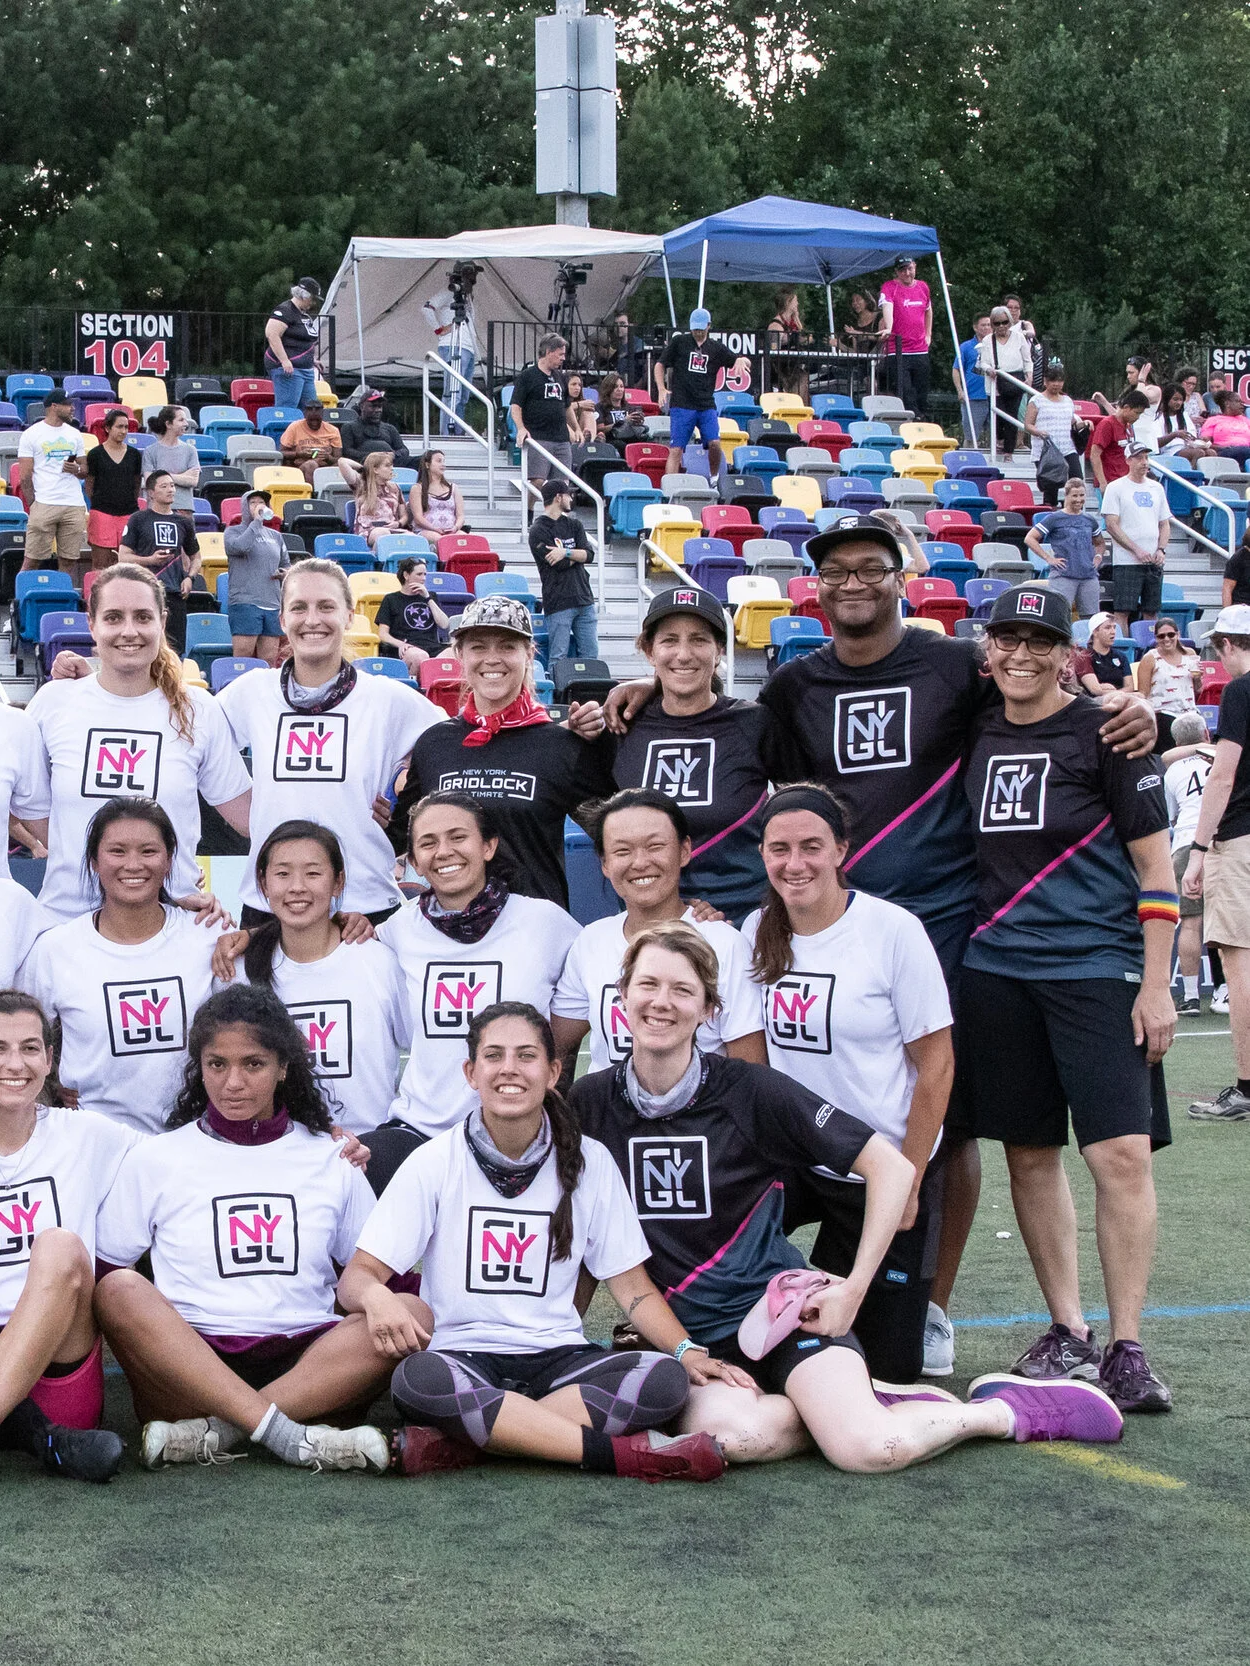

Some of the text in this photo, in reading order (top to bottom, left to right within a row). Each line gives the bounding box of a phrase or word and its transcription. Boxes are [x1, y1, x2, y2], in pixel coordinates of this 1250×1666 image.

[81, 313, 173, 338] SECTION
[85, 340, 170, 376] 104
[1212, 348, 1250, 370] SEC
[846, 711, 896, 744] NY
[287, 731, 334, 756] NY
[96, 746, 147, 774] NY
[654, 758, 701, 783] NY
[443, 776, 528, 792] GRIDLOCK
[992, 773, 1034, 802] NY
[434, 982, 486, 1010] NY
[772, 989, 819, 1022] NY
[120, 996, 170, 1029] NY
[611, 1005, 633, 1034] N
[642, 1158, 693, 1192] NY
[228, 1214, 284, 1246] NY
[481, 1231, 538, 1264] NY
